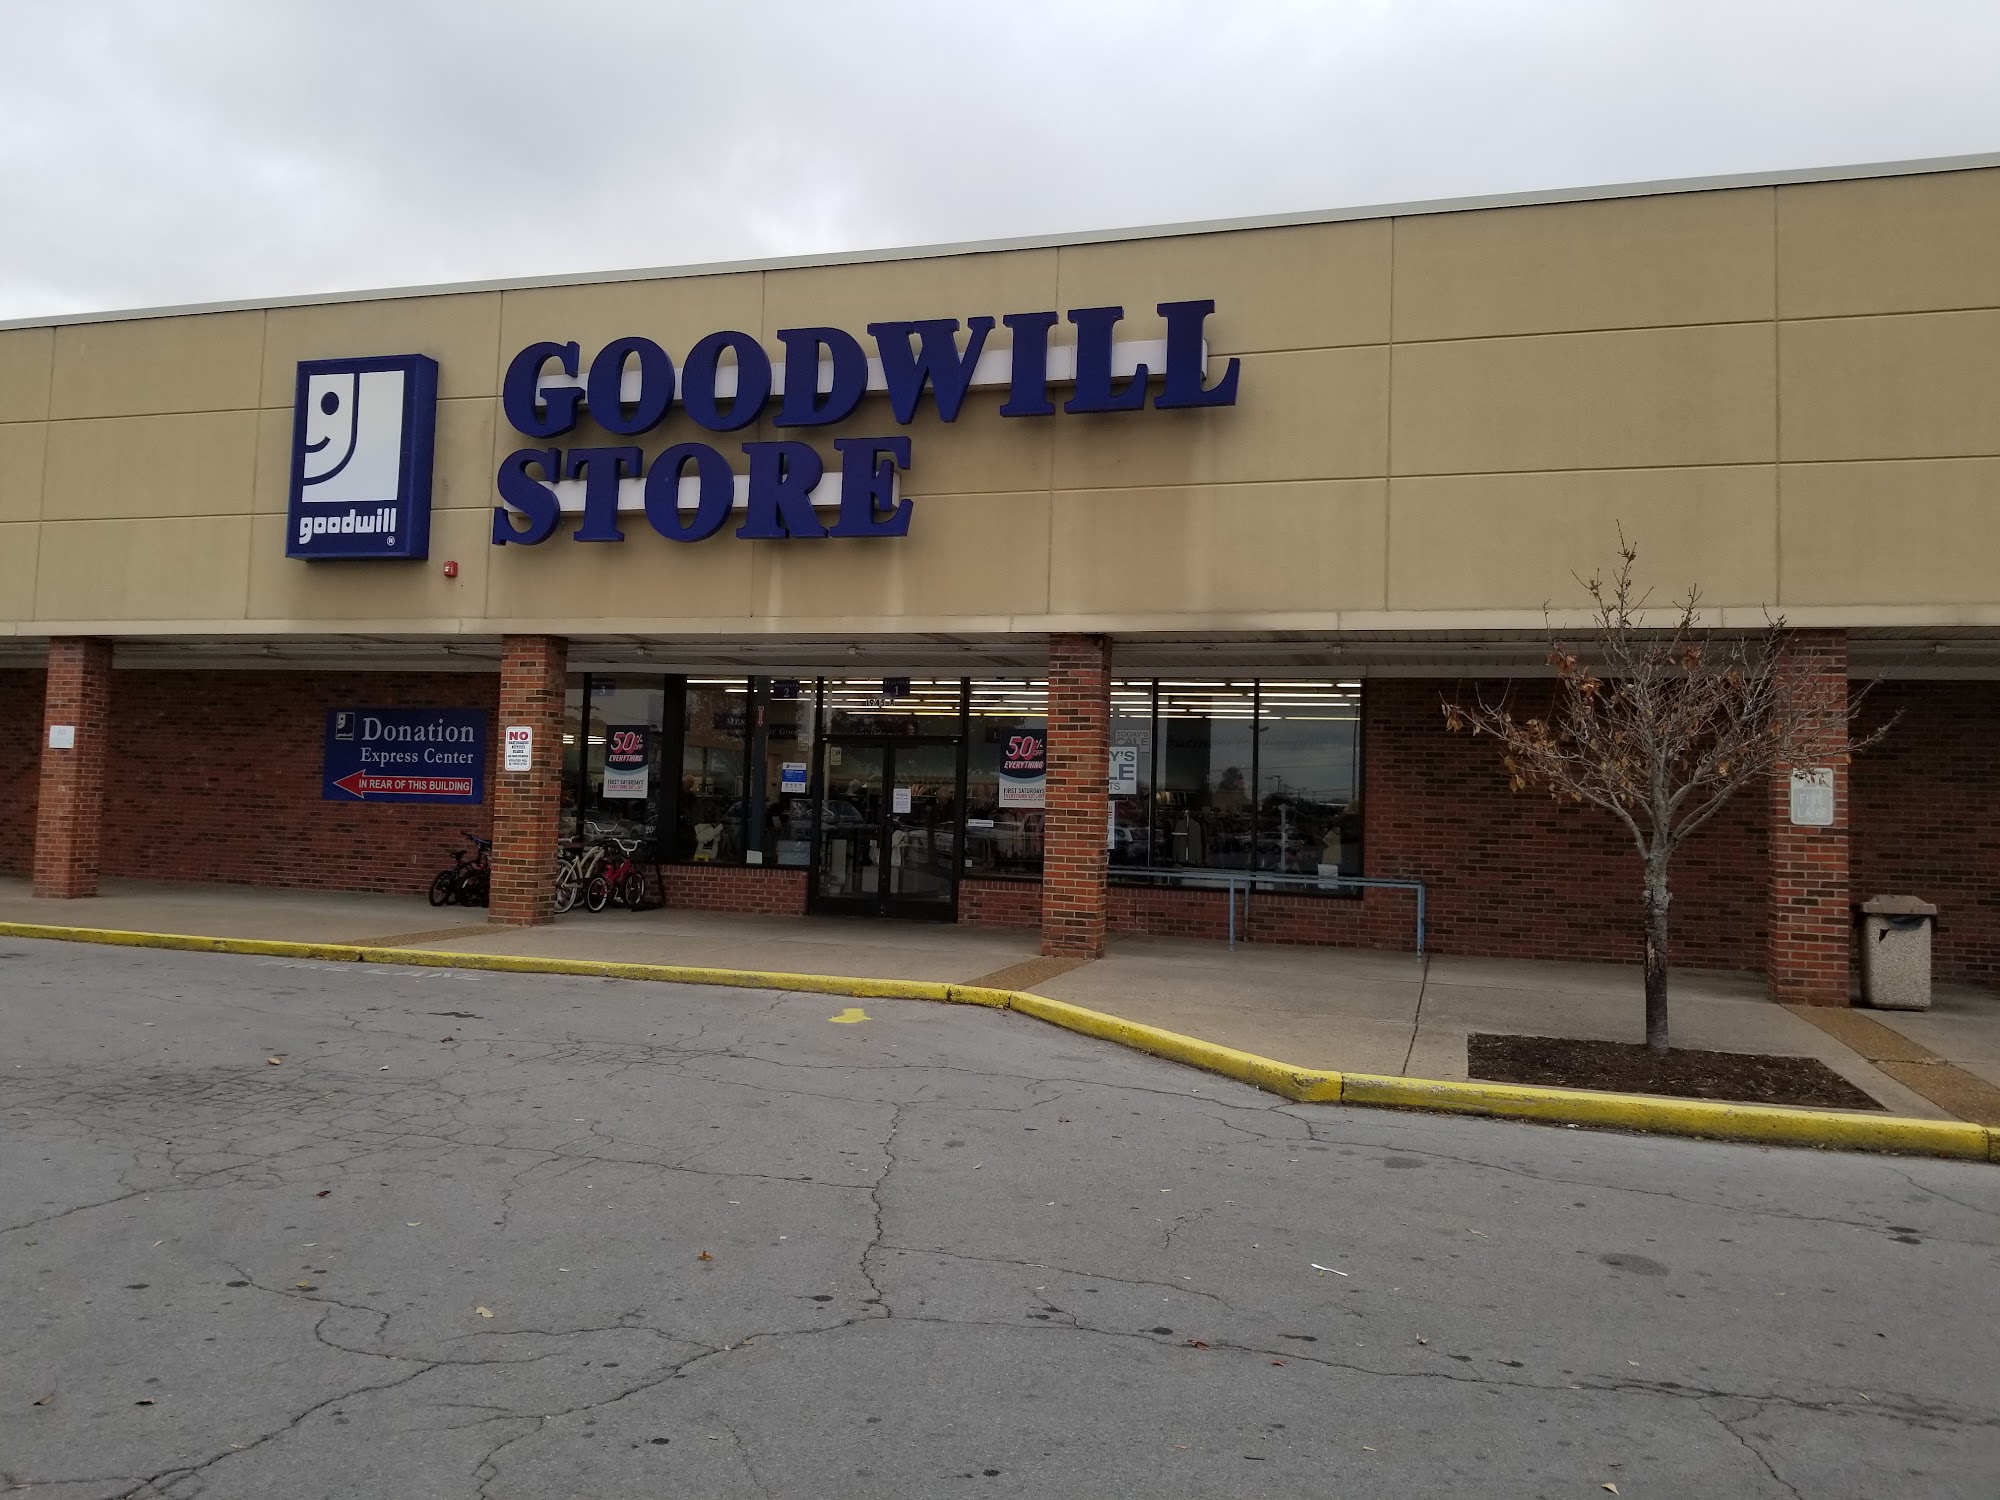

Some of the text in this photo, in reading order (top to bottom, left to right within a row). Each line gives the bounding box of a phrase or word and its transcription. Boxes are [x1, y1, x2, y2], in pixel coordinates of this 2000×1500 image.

[502, 299, 1240, 438] GOODWILL
[492, 436, 913, 546] STORE
[298, 508, 397, 545] goodwill
[783, 687, 790, 698] 2
[894, 686, 900, 696] 1
[361, 717, 475, 743] Donation
[509, 731, 529, 741] NO
[610, 731, 643, 753] 50%
[1005, 735, 1043, 758] 50%
[359, 747, 474, 768] Express Center
[608, 754, 644, 763] EVERYTHING
[1003, 760, 1044, 770] EVERYTHING
[1109, 751, 1135, 762] Y'S
[358, 779, 470, 792] IN REAR OF THIS BUILDING
